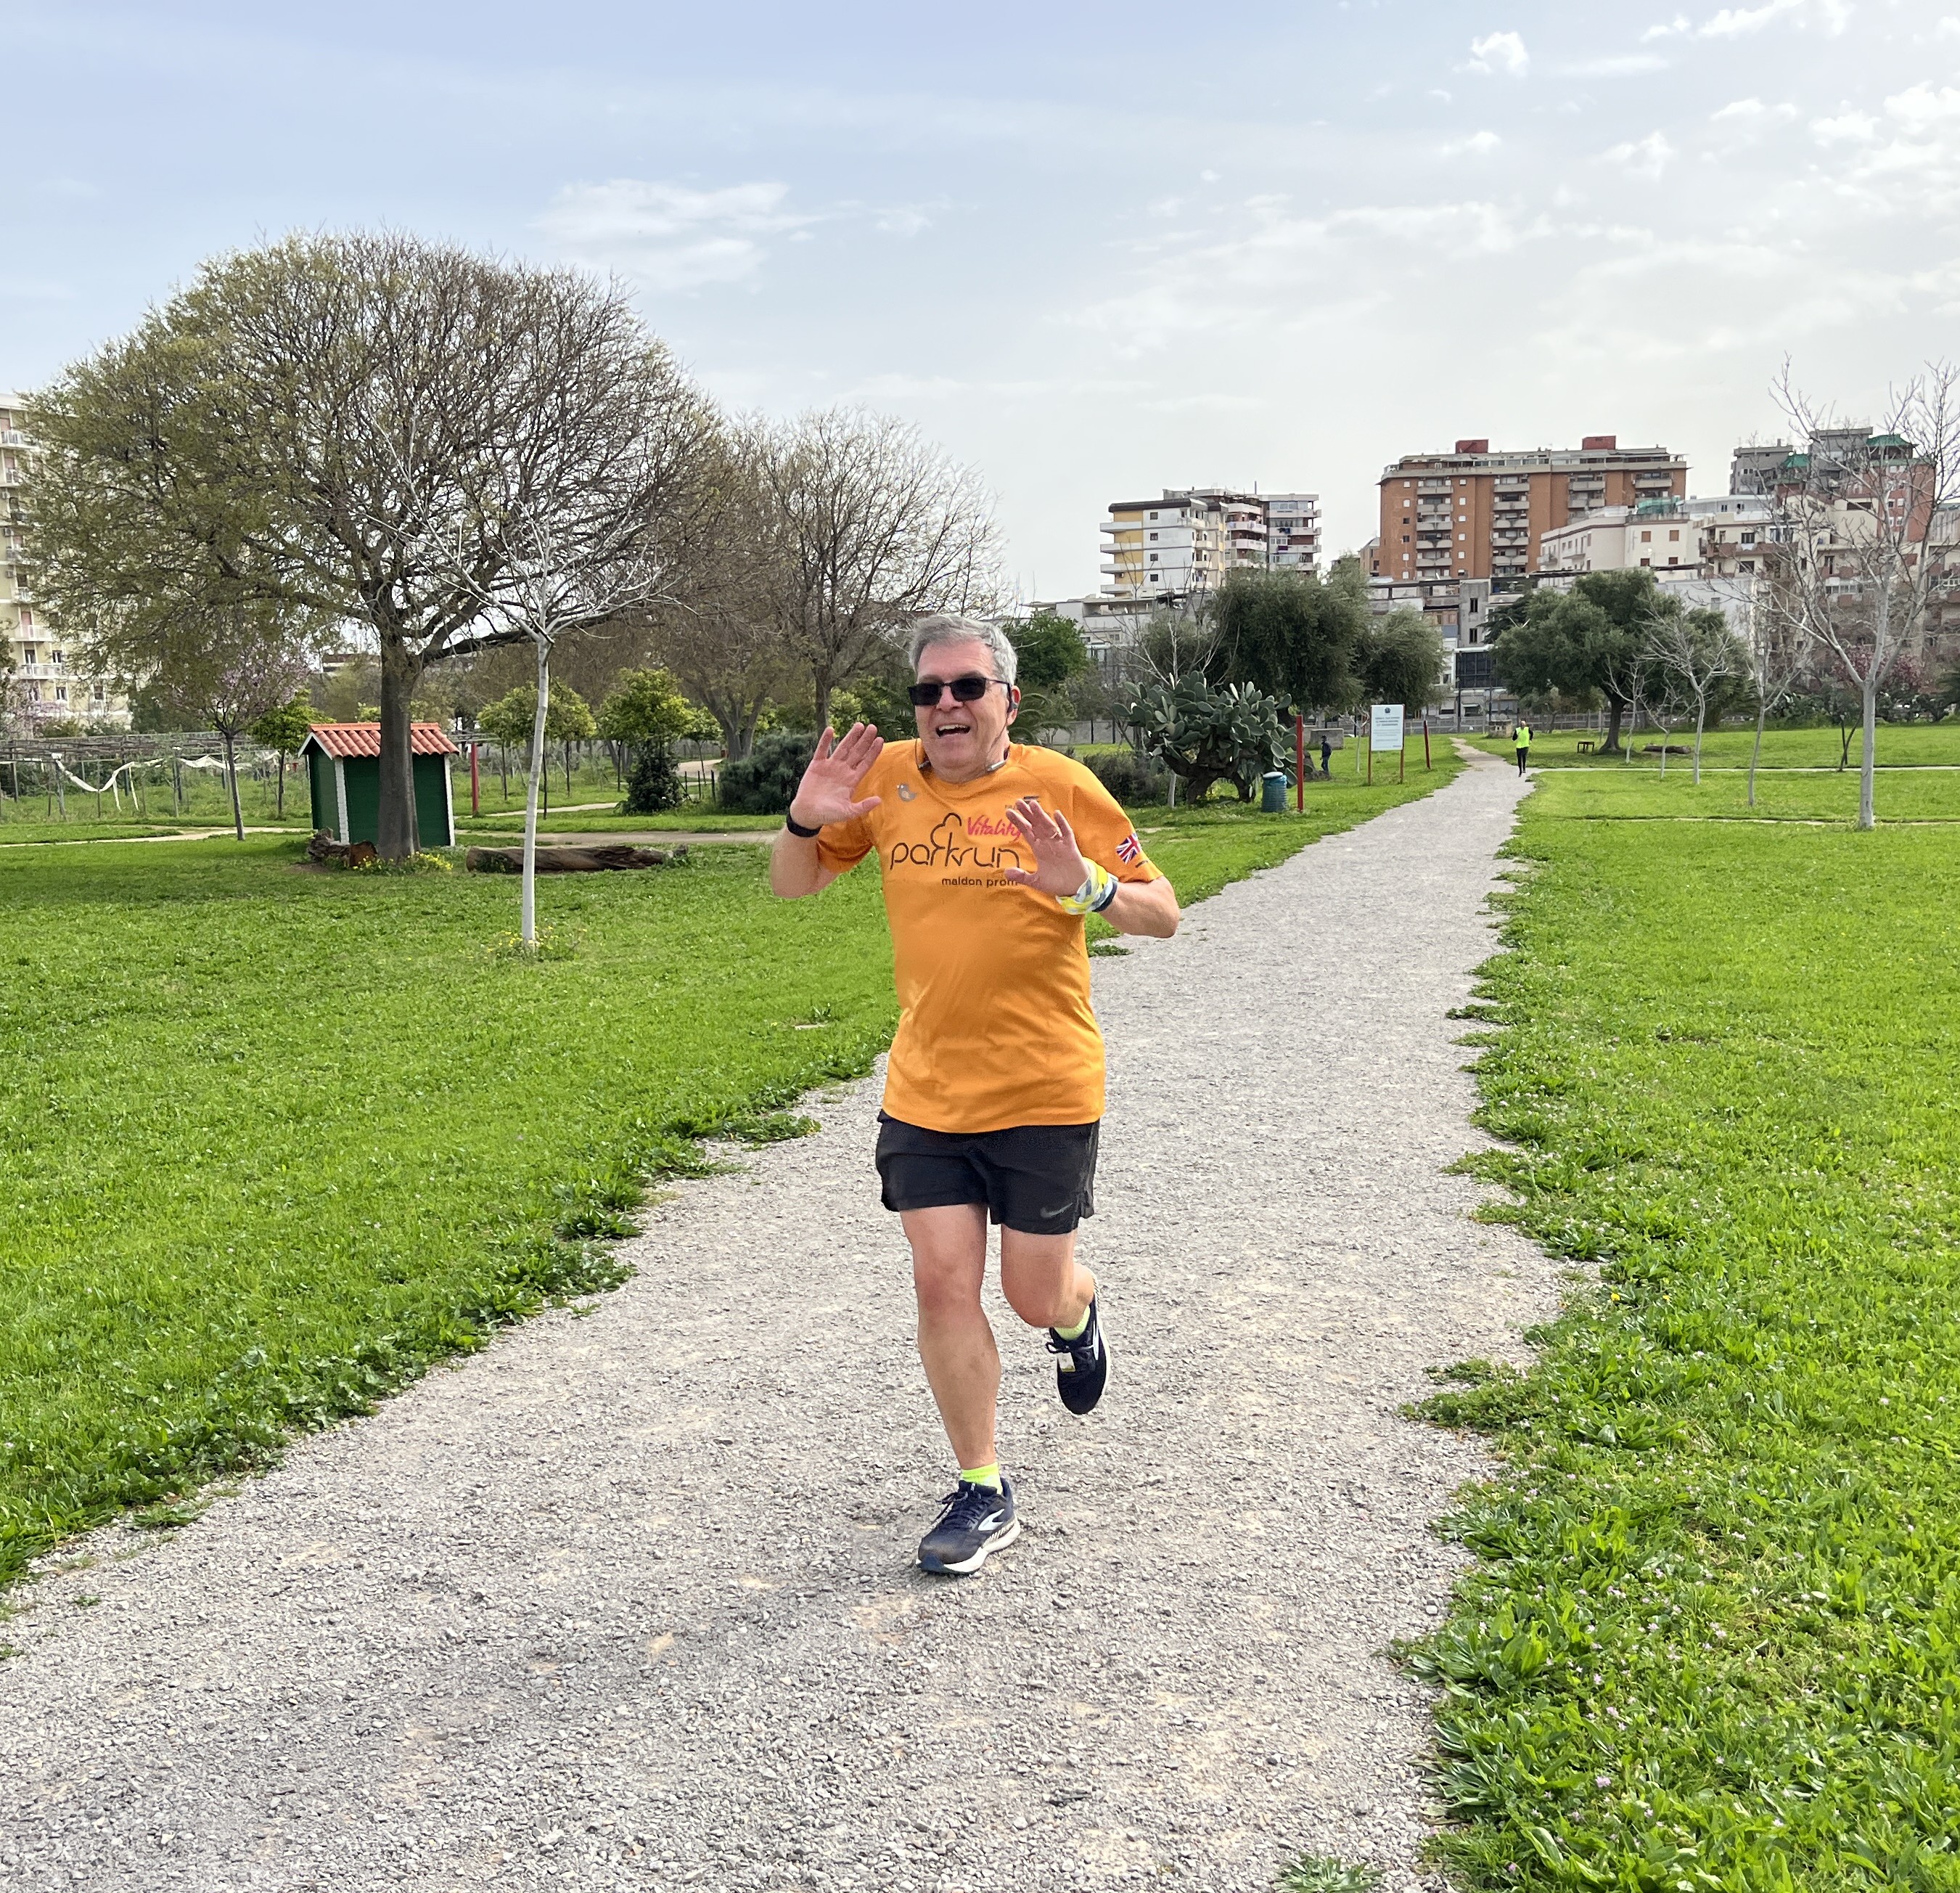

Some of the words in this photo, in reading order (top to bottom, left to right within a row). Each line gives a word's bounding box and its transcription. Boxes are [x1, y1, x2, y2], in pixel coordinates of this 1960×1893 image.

[890, 812, 1020, 870] parkrun
[967, 814, 1022, 843] Vitality
[941, 876, 983, 886] maldon
